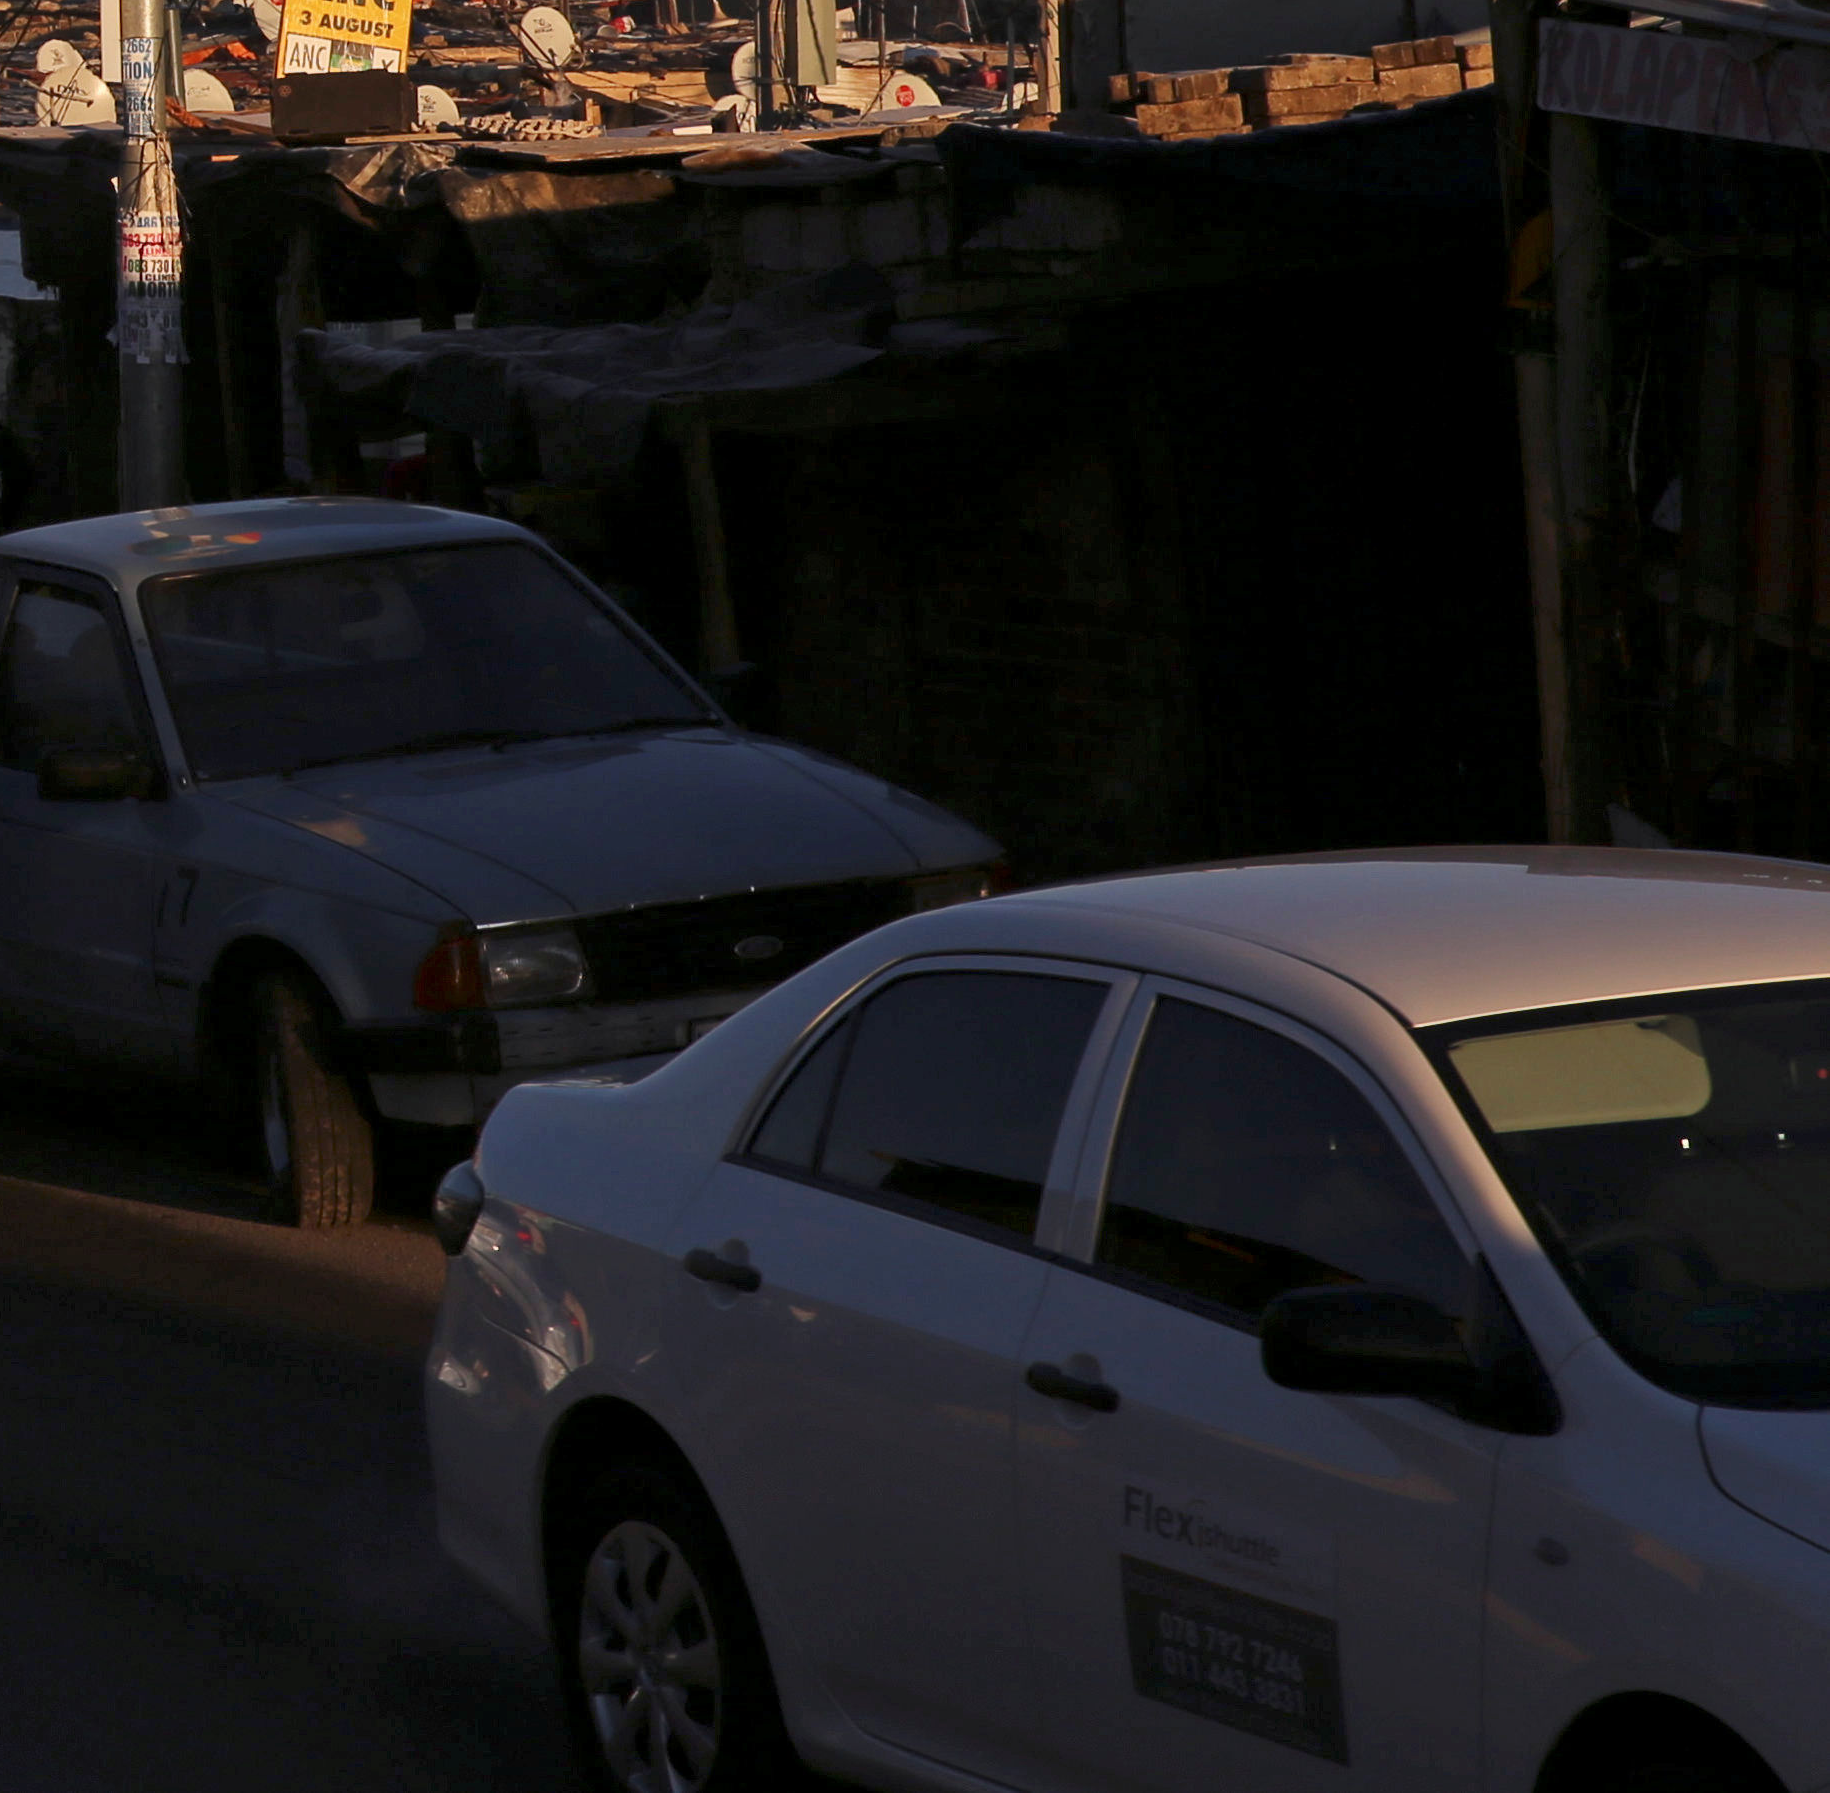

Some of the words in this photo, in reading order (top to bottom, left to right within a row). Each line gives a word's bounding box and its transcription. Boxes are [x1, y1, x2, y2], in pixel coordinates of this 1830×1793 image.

[300, 10, 313, 26] 3
[319, 13, 394, 39] AUGUST
[289, 42, 328, 71] ANC
